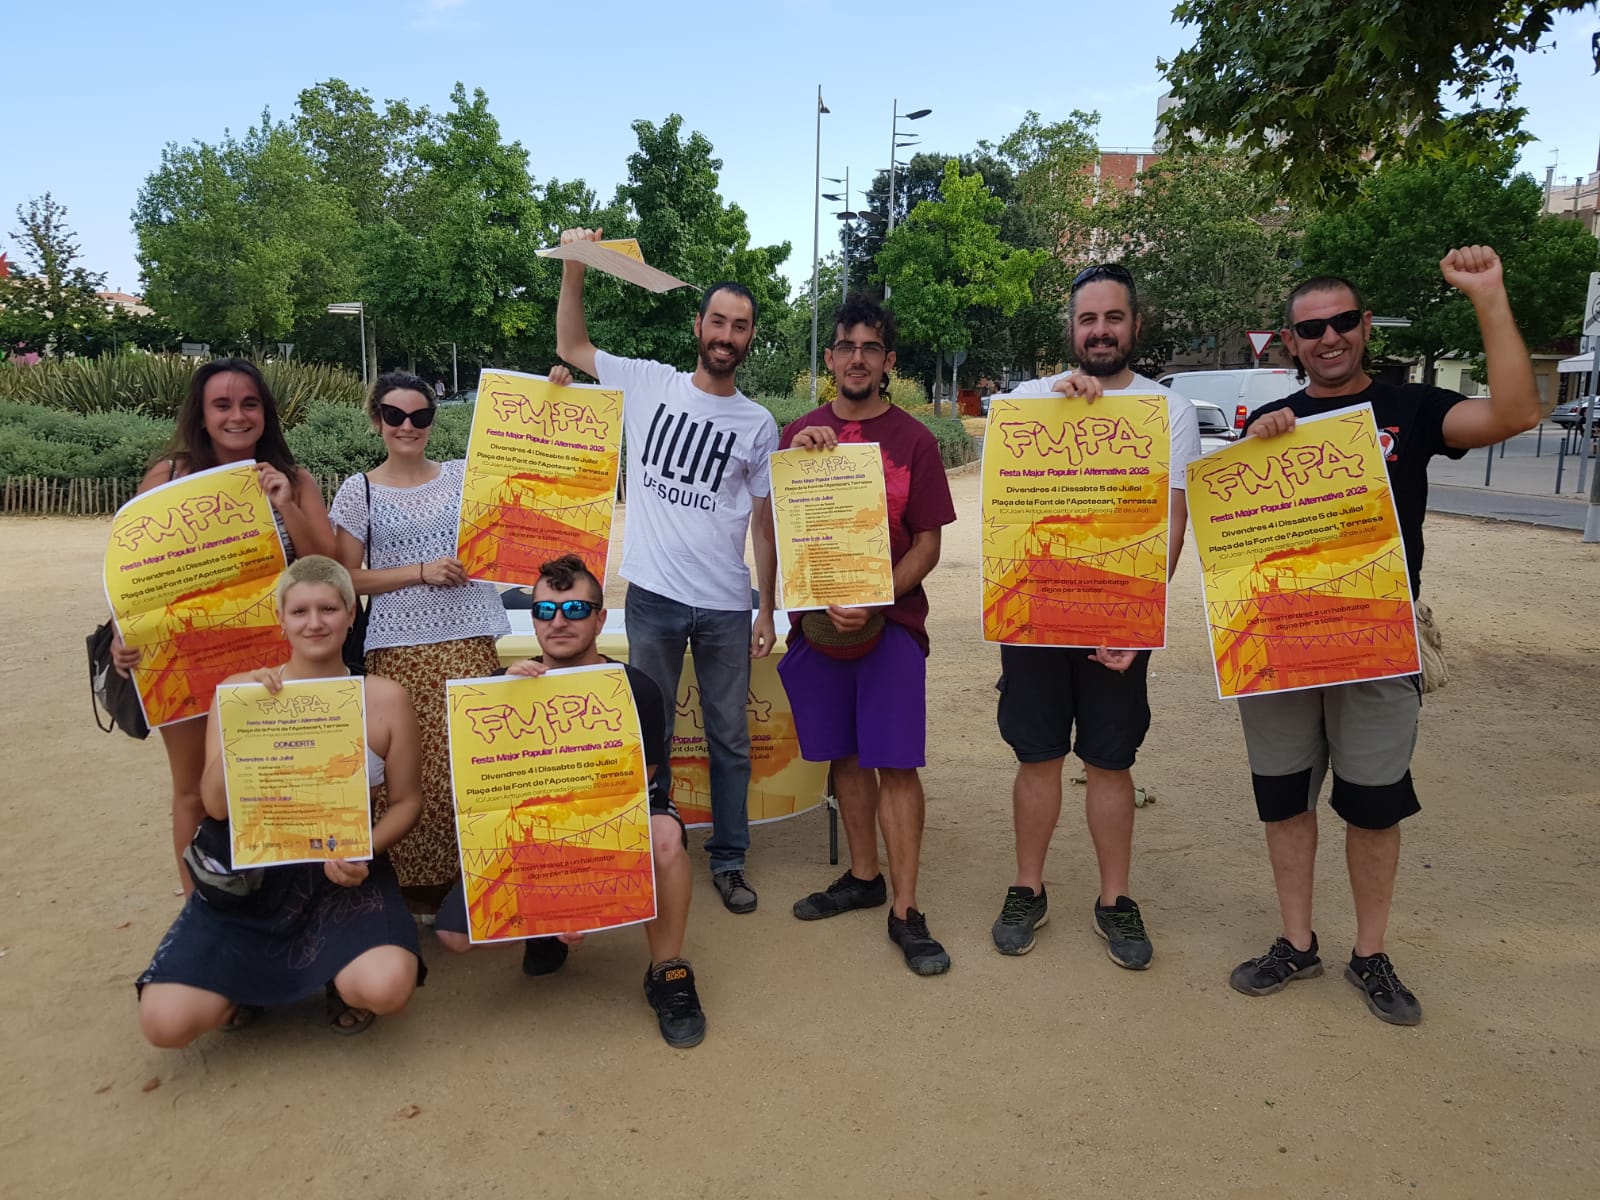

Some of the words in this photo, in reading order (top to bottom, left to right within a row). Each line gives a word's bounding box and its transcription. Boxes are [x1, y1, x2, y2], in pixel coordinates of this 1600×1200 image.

[1022, 468, 1046, 478] Major
[1048, 468, 1078, 477] Popular
[1084, 467, 1126, 475] Alternativa
[1128, 467, 1150, 475] 2025
[1210, 513, 1234, 523] Festa
[1234, 508, 1259, 518] Major
[1260, 502, 1292, 513] Popular
[1298, 492, 1344, 506] Alternativa
[1346, 485, 1368, 496] 2025
[1209, 544, 1232, 552] Plaça
[1254, 536, 1274, 544] Font
[1340, 516, 1384, 528] Terrassa
[1222, 524, 1267, 538] Divendres
[1278, 516, 1318, 527] Dissabte
[1339, 505, 1364, 516] Juliol
[472, 756, 494, 764] Festa
[496, 752, 520, 761] Major
[522, 748, 554, 758] Popular
[560, 743, 601, 754] Alternativa
[604, 739, 623, 749] 2025
[481, 770, 526, 780] Divendres
[538, 764, 575, 773] Dissabte
[596, 758, 618, 766] Juliol
[466, 788, 490, 796] Plaça
[595, 770, 634, 779] Terrassa
